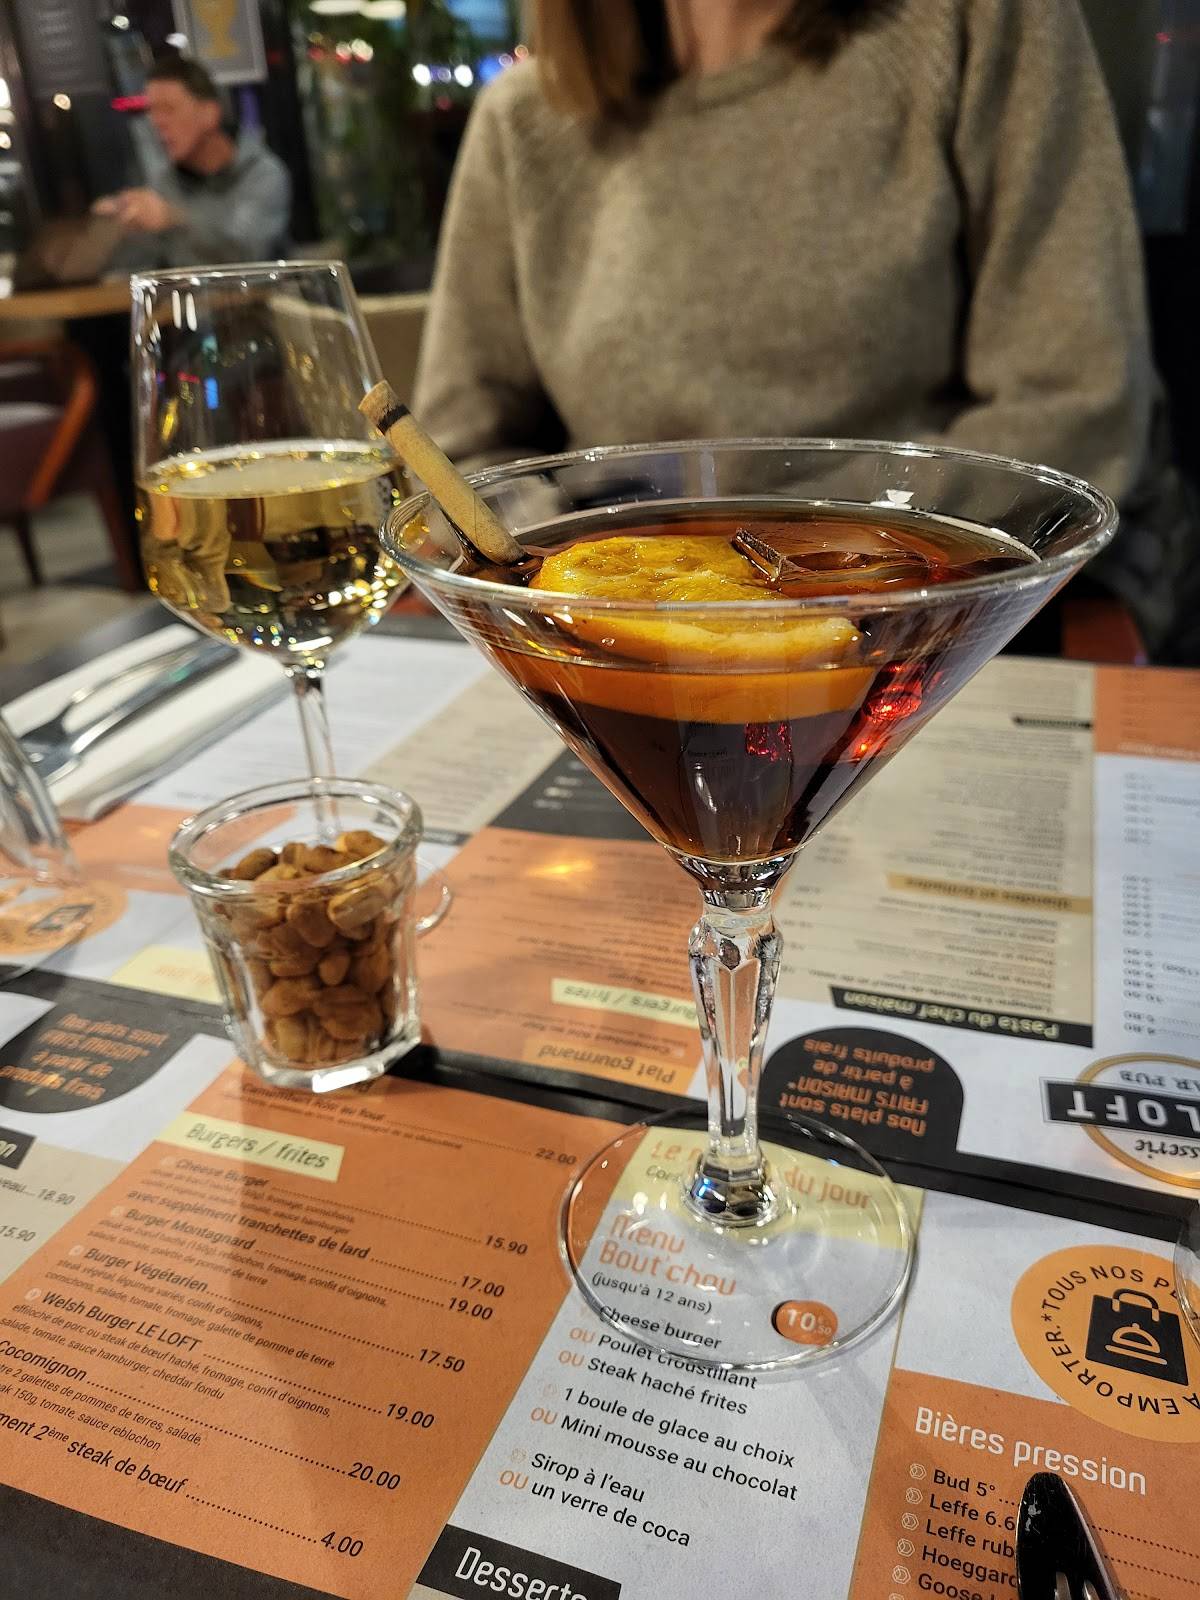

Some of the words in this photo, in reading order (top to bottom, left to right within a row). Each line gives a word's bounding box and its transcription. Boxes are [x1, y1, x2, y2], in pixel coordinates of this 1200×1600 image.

[843, 991, 917, 1014] maison
[918, 1003, 965, 1023] chef
[968, 1012, 995, 1029] du
[803, 1039, 848, 1060] frais
[998, 1016, 1060, 1039] Pasta
[813, 1059, 838, 1075] de
[842, 1065, 896, 1086] partir
[853, 1047, 936, 1073] produits
[1119, 1070, 1166, 1087] PUB
[779, 1093, 826, 1113] sont
[830, 1102, 884, 1125] plats
[875, 1090, 929, 1116] FAITS
[887, 1113, 926, 1137] Nos
[1067, 1090, 1200, 1133] LOFT
[185, 1122, 255, 1152] Burgers
[274, 1142, 330, 1170] frites
[820, 1176, 871, 1209] jour
[125, 1208, 170, 1227] Burger
[171, 1219, 256, 1250] Montagnard
[448, 1296, 493, 1321] 19.00
[238, 1215, 317, 1244] tranchettes
[318, 1236, 338, 1250] de
[339, 1241, 371, 1260] lard
[460, 1275, 506, 1299] 17.00
[485, 1234, 529, 1256] 15.90
[599, 1240, 737, 1296] Bout'chou
[1089, 1265, 1144, 1283] NOS
[84, 1248, 133, 1271] Burger
[134, 1261, 208, 1292] Végétarien
[418, 1348, 466, 1373] 17.50
[592, 1271, 650, 1297] (jusqu'à
[656, 1288, 675, 1303] 12
[677, 1295, 713, 1316] ans)
[32, 1327, 67, 1346] tomate,
[68, 1340, 98, 1357] sauce
[97, 1349, 150, 1375] hamburger,
[152, 1367, 194, 1390] cheddar
[193, 1381, 226, 1400] fondu
[42, 1291, 86, 1315] Welsh
[85, 1305, 135, 1330] Burger
[136, 1321, 160, 1339] LE
[157, 1328, 203, 1352] LOFT
[386, 1403, 435, 1429] 19.00
[51, 1315, 64, 1327] de
[63, 1320, 87, 1335] porc
[87, 1329, 100, 1339] ou
[100, 1331, 128, 1347] steak
[128, 1341, 141, 1353] de
[141, 1345, 171, 1361] bœuf
[201, 1365, 246, 1390] fromage,
[247, 1382, 278, 1399] confit
[278, 1390, 331, 1419] d'oignons,
[207, 1322, 241, 1339] galette
[242, 1333, 256, 1345] de
[255, 1337, 295, 1357] pomme
[296, 1348, 310, 1361] de
[310, 1353, 337, 1369] terre
[598, 1334, 653, 1361] Poulet
[657, 1350, 758, 1390] croustillant
[12, 1368, 23, 1380] 2
[20, 1370, 60, 1393] galettes
[60, 1386, 74, 1398] de
[72, 1392, 121, 1414] pommes
[118, 1406, 133, 1419] de
[132, 1413, 163, 1434] terres,
[166, 1425, 202, 1447] salade,
[588, 1358, 639, 1383] Steak
[640, 1372, 696, 1400] haché
[700, 1389, 748, 1415] frites
[0, 1340, 87, 1383] Cocomignon
[348, 1462, 401, 1490] 20.00
[13, 1387, 38, 1407] 150g,
[39, 1399, 76, 1421] tomate,
[77, 1413, 110, 1431] sauce
[108, 1424, 161, 1451] reblochon
[565, 1387, 574, 1401] 1
[577, 1390, 628, 1417] boule
[632, 1408, 655, 1426] de
[658, 1418, 709, 1443] glace
[714, 1435, 738, 1452] au
[743, 1442, 796, 1468] choix
[530, 1407, 558, 1425] OU
[560, 1415, 602, 1439] Mini
[604, 1430, 680, 1464] mousse
[683, 1456, 708, 1474] au
[712, 1464, 799, 1501] chocolat
[915, 1406, 1004, 1455] Bières
[1013, 1439, 1147, 1496] pression
[67, 1440, 114, 1467] steak
[114, 1457, 137, 1476] de
[137, 1464, 189, 1494] bœuf
[320, 1531, 364, 1557] 4.00
[531, 1453, 580, 1482] Sirop
[583, 1468, 596, 1486] à
[600, 1473, 646, 1503] l'eau
[934, 1469, 970, 1493] Bud
[976, 1482, 996, 1497] 5°
[499, 1470, 529, 1490] OU
[531, 1482, 556, 1500] un
[561, 1491, 608, 1517] verre
[613, 1506, 637, 1529] de
[642, 1520, 690, 1547] coca
[930, 1494, 979, 1521] Leffe
[926, 1519, 976, 1548] Leffe
